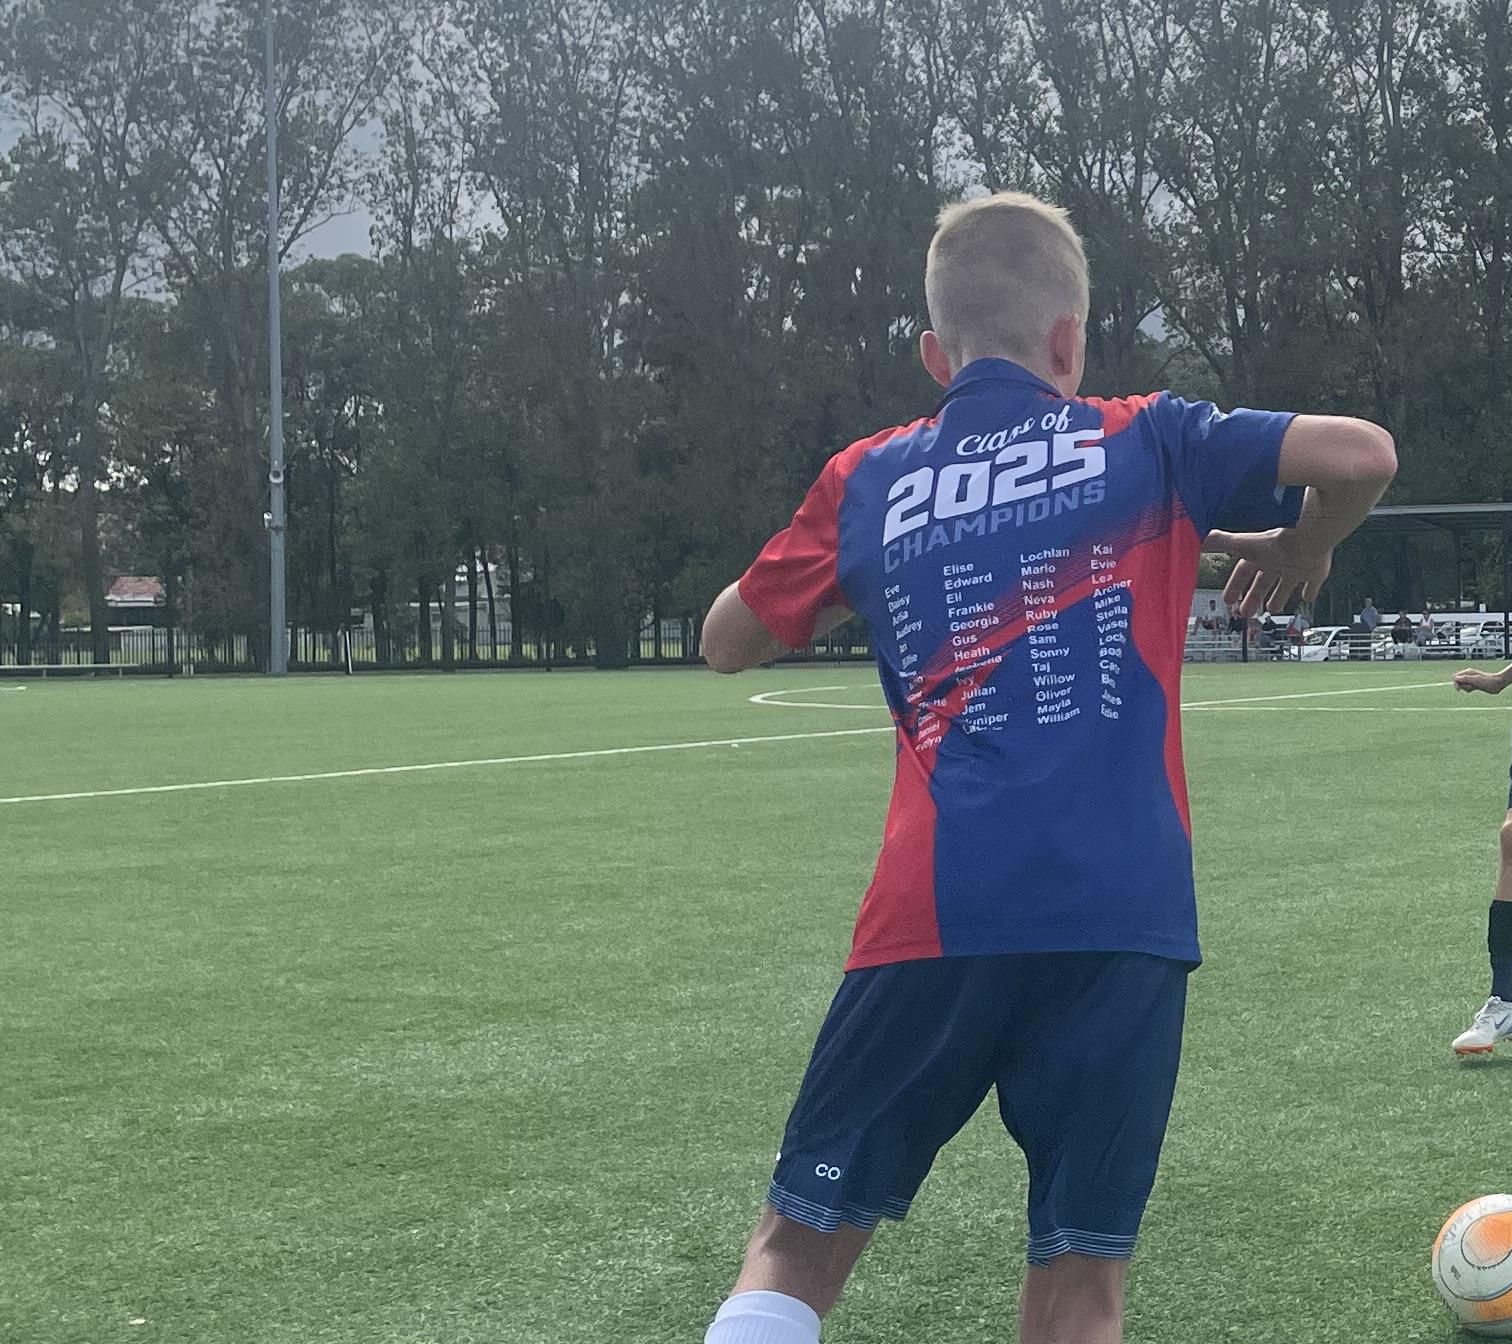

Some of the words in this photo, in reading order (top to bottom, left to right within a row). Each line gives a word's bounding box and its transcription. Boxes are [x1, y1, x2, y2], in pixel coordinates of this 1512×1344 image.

[956, 417, 1036, 456] Class
[1041, 404, 1073, 431] of
[882, 428, 1106, 547] 2025
[884, 479, 1106, 574] CHAMPIONS
[1020, 548, 1070, 563] Lochlan
[1093, 544, 1113, 555] Kai
[943, 563, 974, 576] Elise
[1021, 563, 1056, 576] Marlo
[1090, 559, 1117, 570] Evie
[944, 572, 993, 590] Edward
[1022, 578, 1055, 591] Nash
[1093, 579, 1132, 598] Archer
[1023, 595, 1055, 606] Neva
[948, 602, 995, 618] Frankie
[1025, 609, 1058, 621] Ruby
[1096, 605, 1128, 622] Stella
[949, 615, 1000, 632] Georgia
[1026, 622, 1059, 633] Rose
[952, 634, 978, 647] Gus
[1028, 635, 1057, 645] Sam
[954, 646, 990, 662] Heath
[1030, 647, 1070, 659] Sonny
[1032, 662, 1050, 673] Taj
[1033, 673, 1076, 687] Willow
[961, 686, 997, 701] Julian
[1036, 686, 1072, 702] Oliver
[962, 702, 986, 716] Jem
[1037, 707, 1081, 724] William
[965, 713, 1009, 726] uniper
